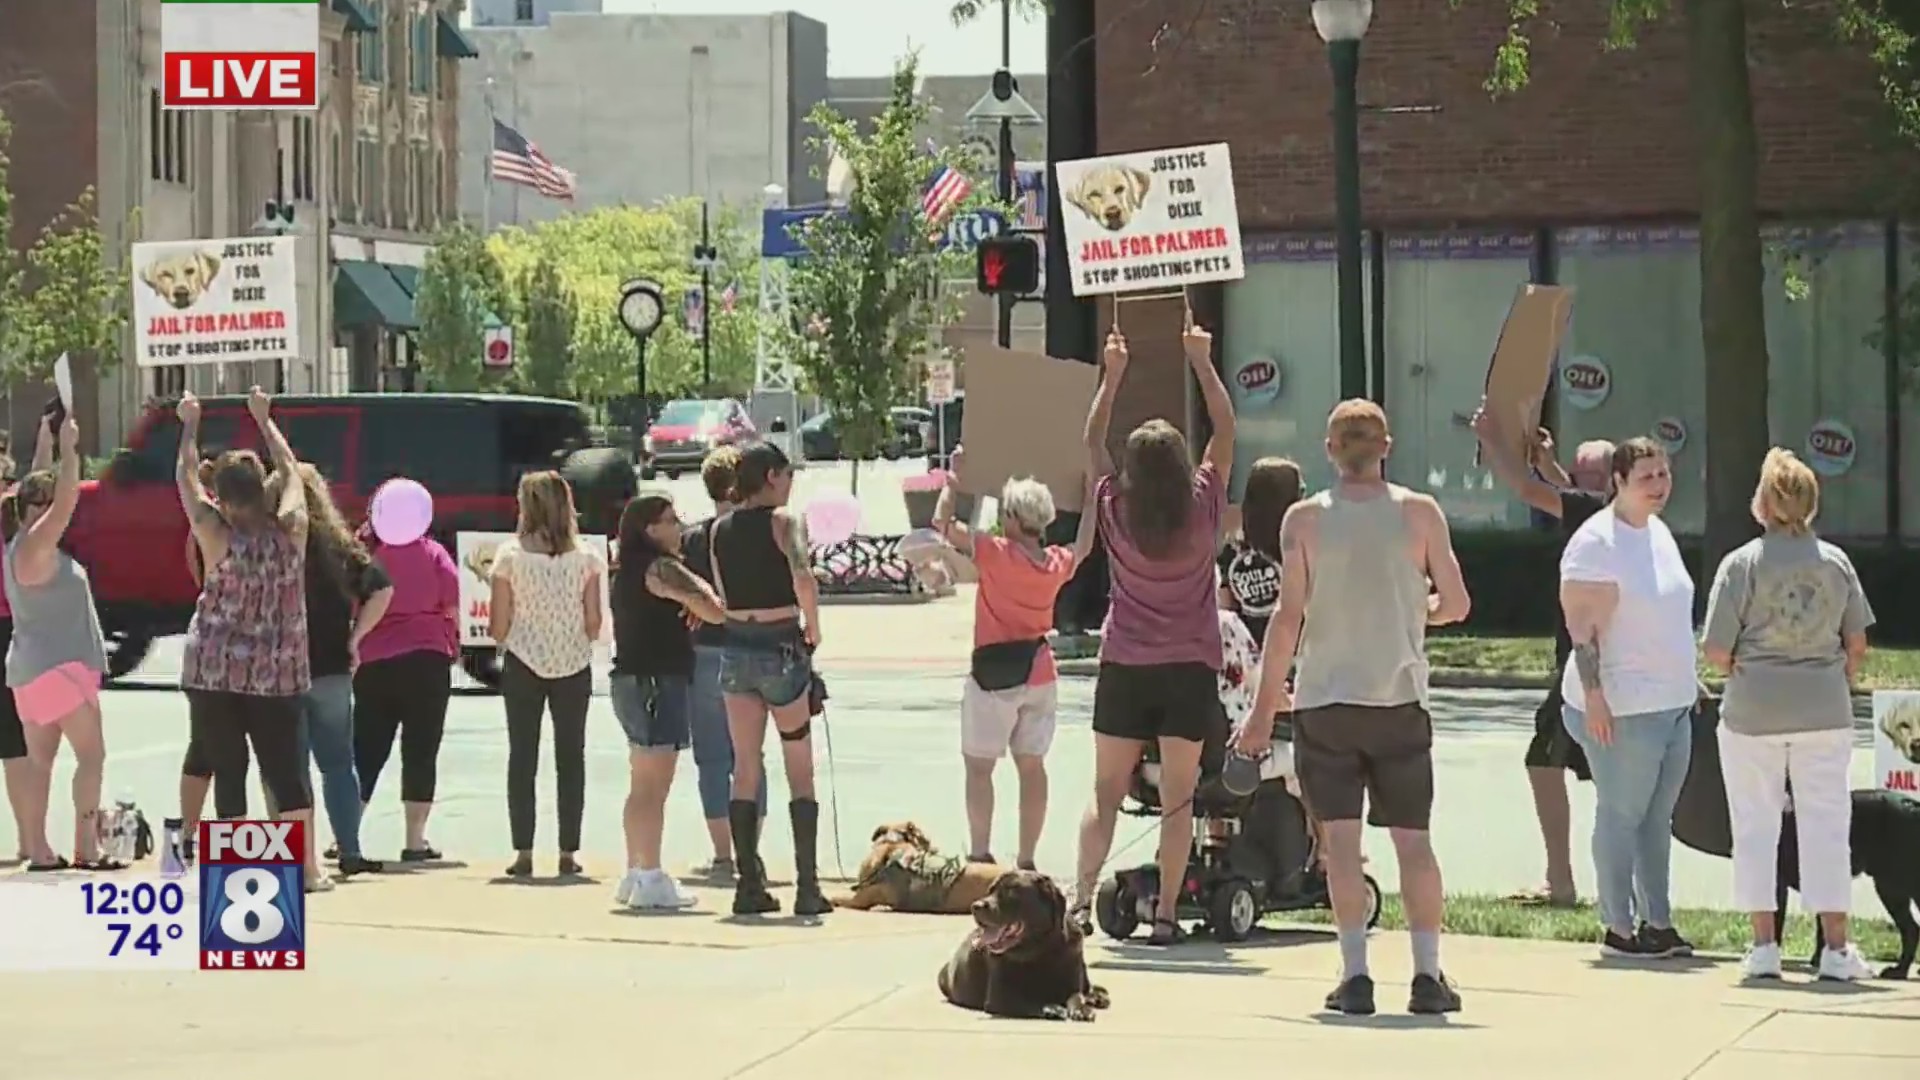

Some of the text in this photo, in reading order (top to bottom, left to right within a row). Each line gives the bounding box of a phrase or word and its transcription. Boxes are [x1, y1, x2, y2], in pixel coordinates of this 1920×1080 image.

[1151, 151, 1207, 173] JUSTICE
[1168, 178, 1195, 195] FOR
[1167, 201, 1202, 219] DIXIE
[221, 242, 274, 258] JUSTICE
[1080, 226, 1228, 262] JAIL FOR PALMER
[235, 264, 261, 280] FOR
[1083, 256, 1231, 286] STOP SHOOTING PETS
[232, 286, 266, 302] DIXIE
[148, 310, 286, 336] JAIL FOR PALMER
[148, 337, 286, 357] STOP SHOOTING PETS
[1885, 770, 1917, 790] JAIL
